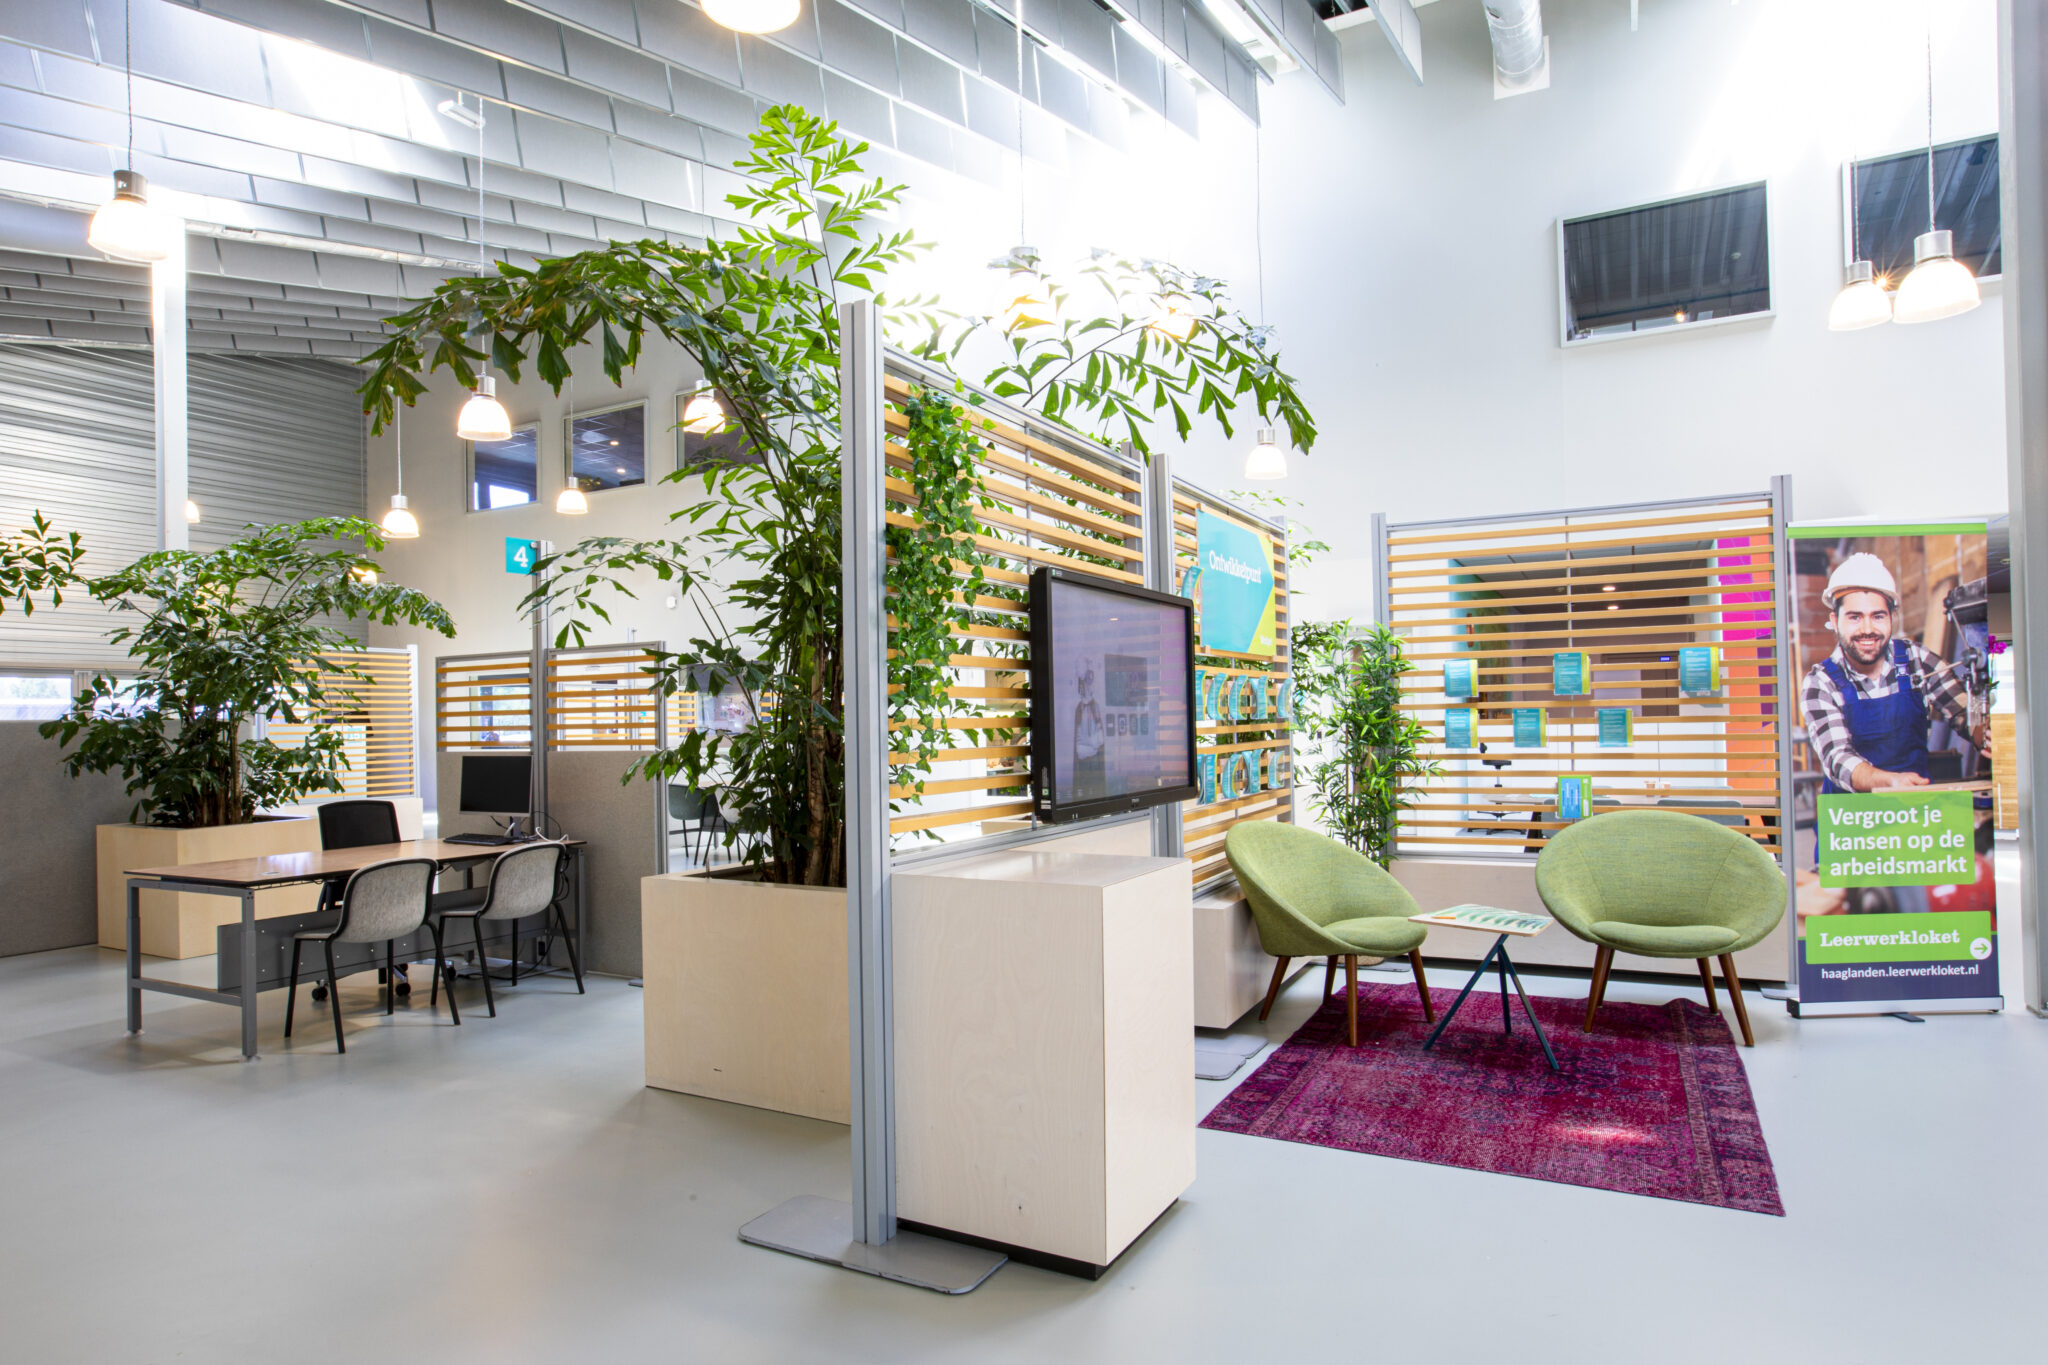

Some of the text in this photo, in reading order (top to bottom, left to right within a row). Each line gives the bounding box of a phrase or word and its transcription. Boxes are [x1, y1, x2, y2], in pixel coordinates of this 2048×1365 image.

[513, 545, 529, 568] 4
[1208, 549, 1262, 584] Ontwikkelpunt
[1828, 805, 1942, 829] Vergroot je
[1829, 829, 1965, 852] kansen op de
[1830, 855, 1967, 876] arbeidsmarkt
[1819, 929, 1960, 947] Leerwerkloket
[1821, 964, 1979, 980] haaglanden.leerwerkloket.nl
